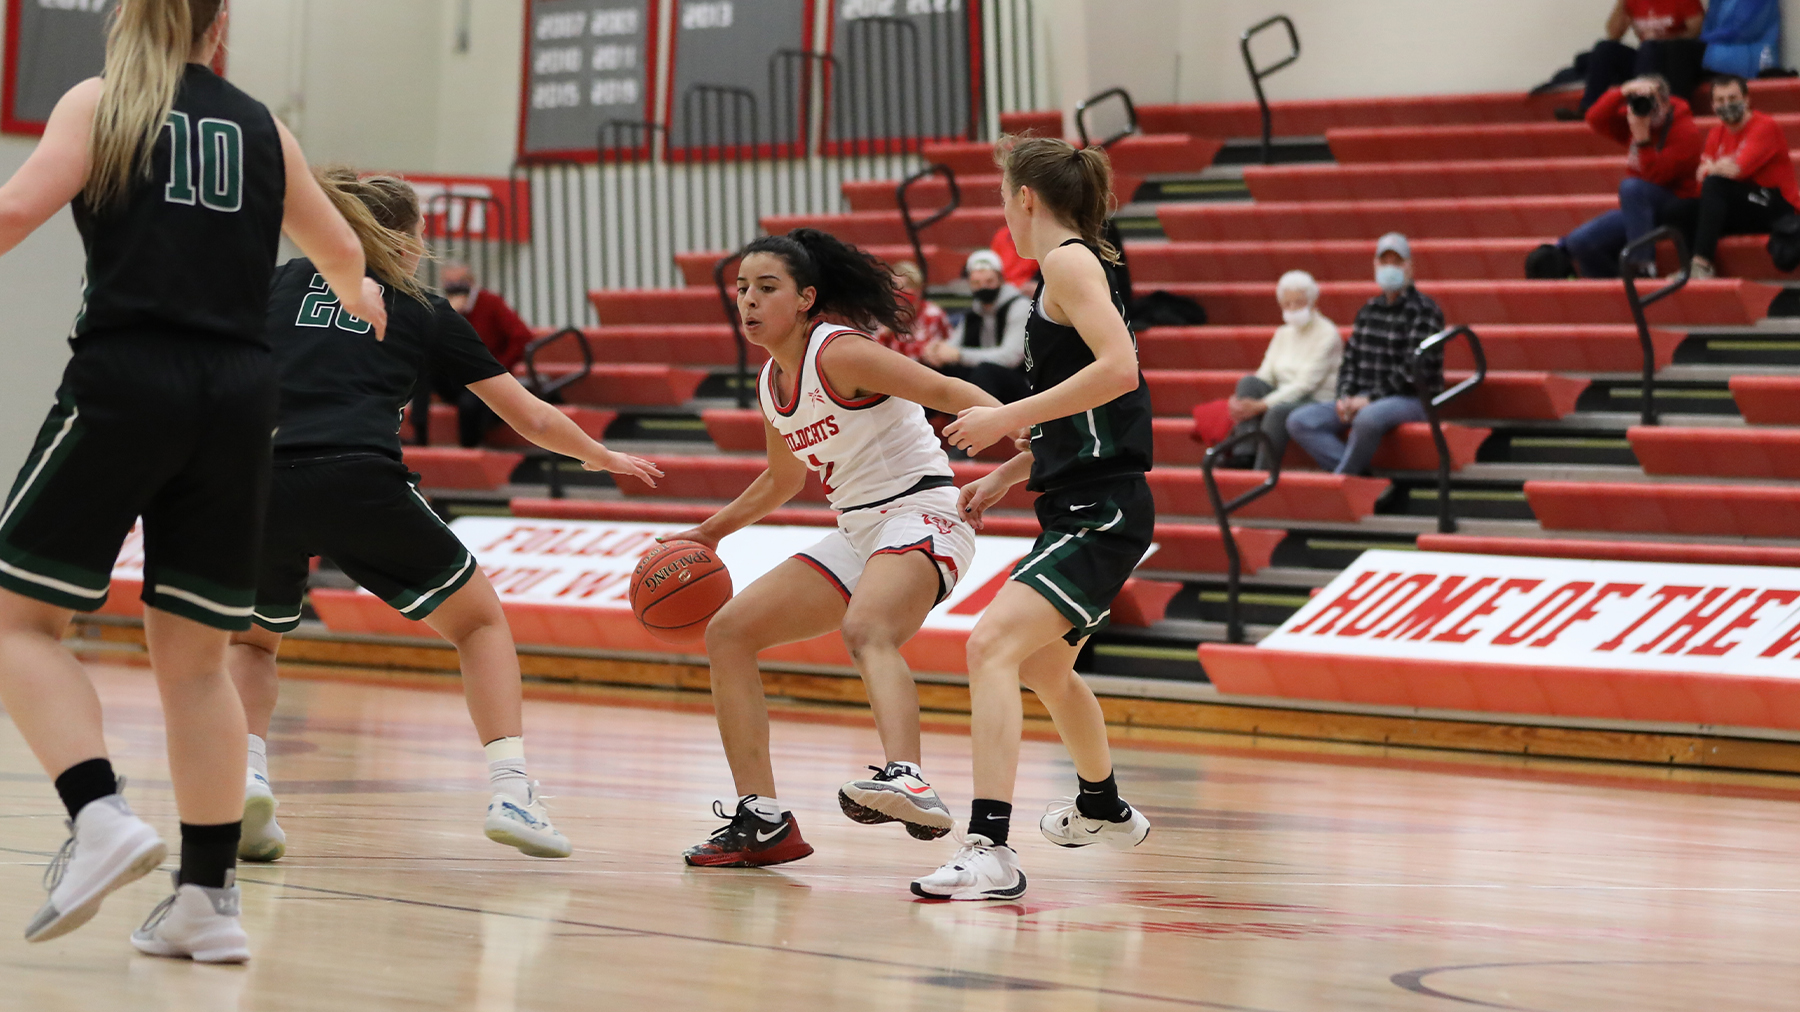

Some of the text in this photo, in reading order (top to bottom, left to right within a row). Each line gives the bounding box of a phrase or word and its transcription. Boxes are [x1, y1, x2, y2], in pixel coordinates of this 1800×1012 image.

[163, 110, 243, 212] 10
[782, 415, 840, 452] ILDCATS
[644, 550, 712, 594] SPALDING
[1287, 570, 1547, 643] HOME
[1489, 580, 1646, 648] OF
[1592, 585, 1800, 657] THE
